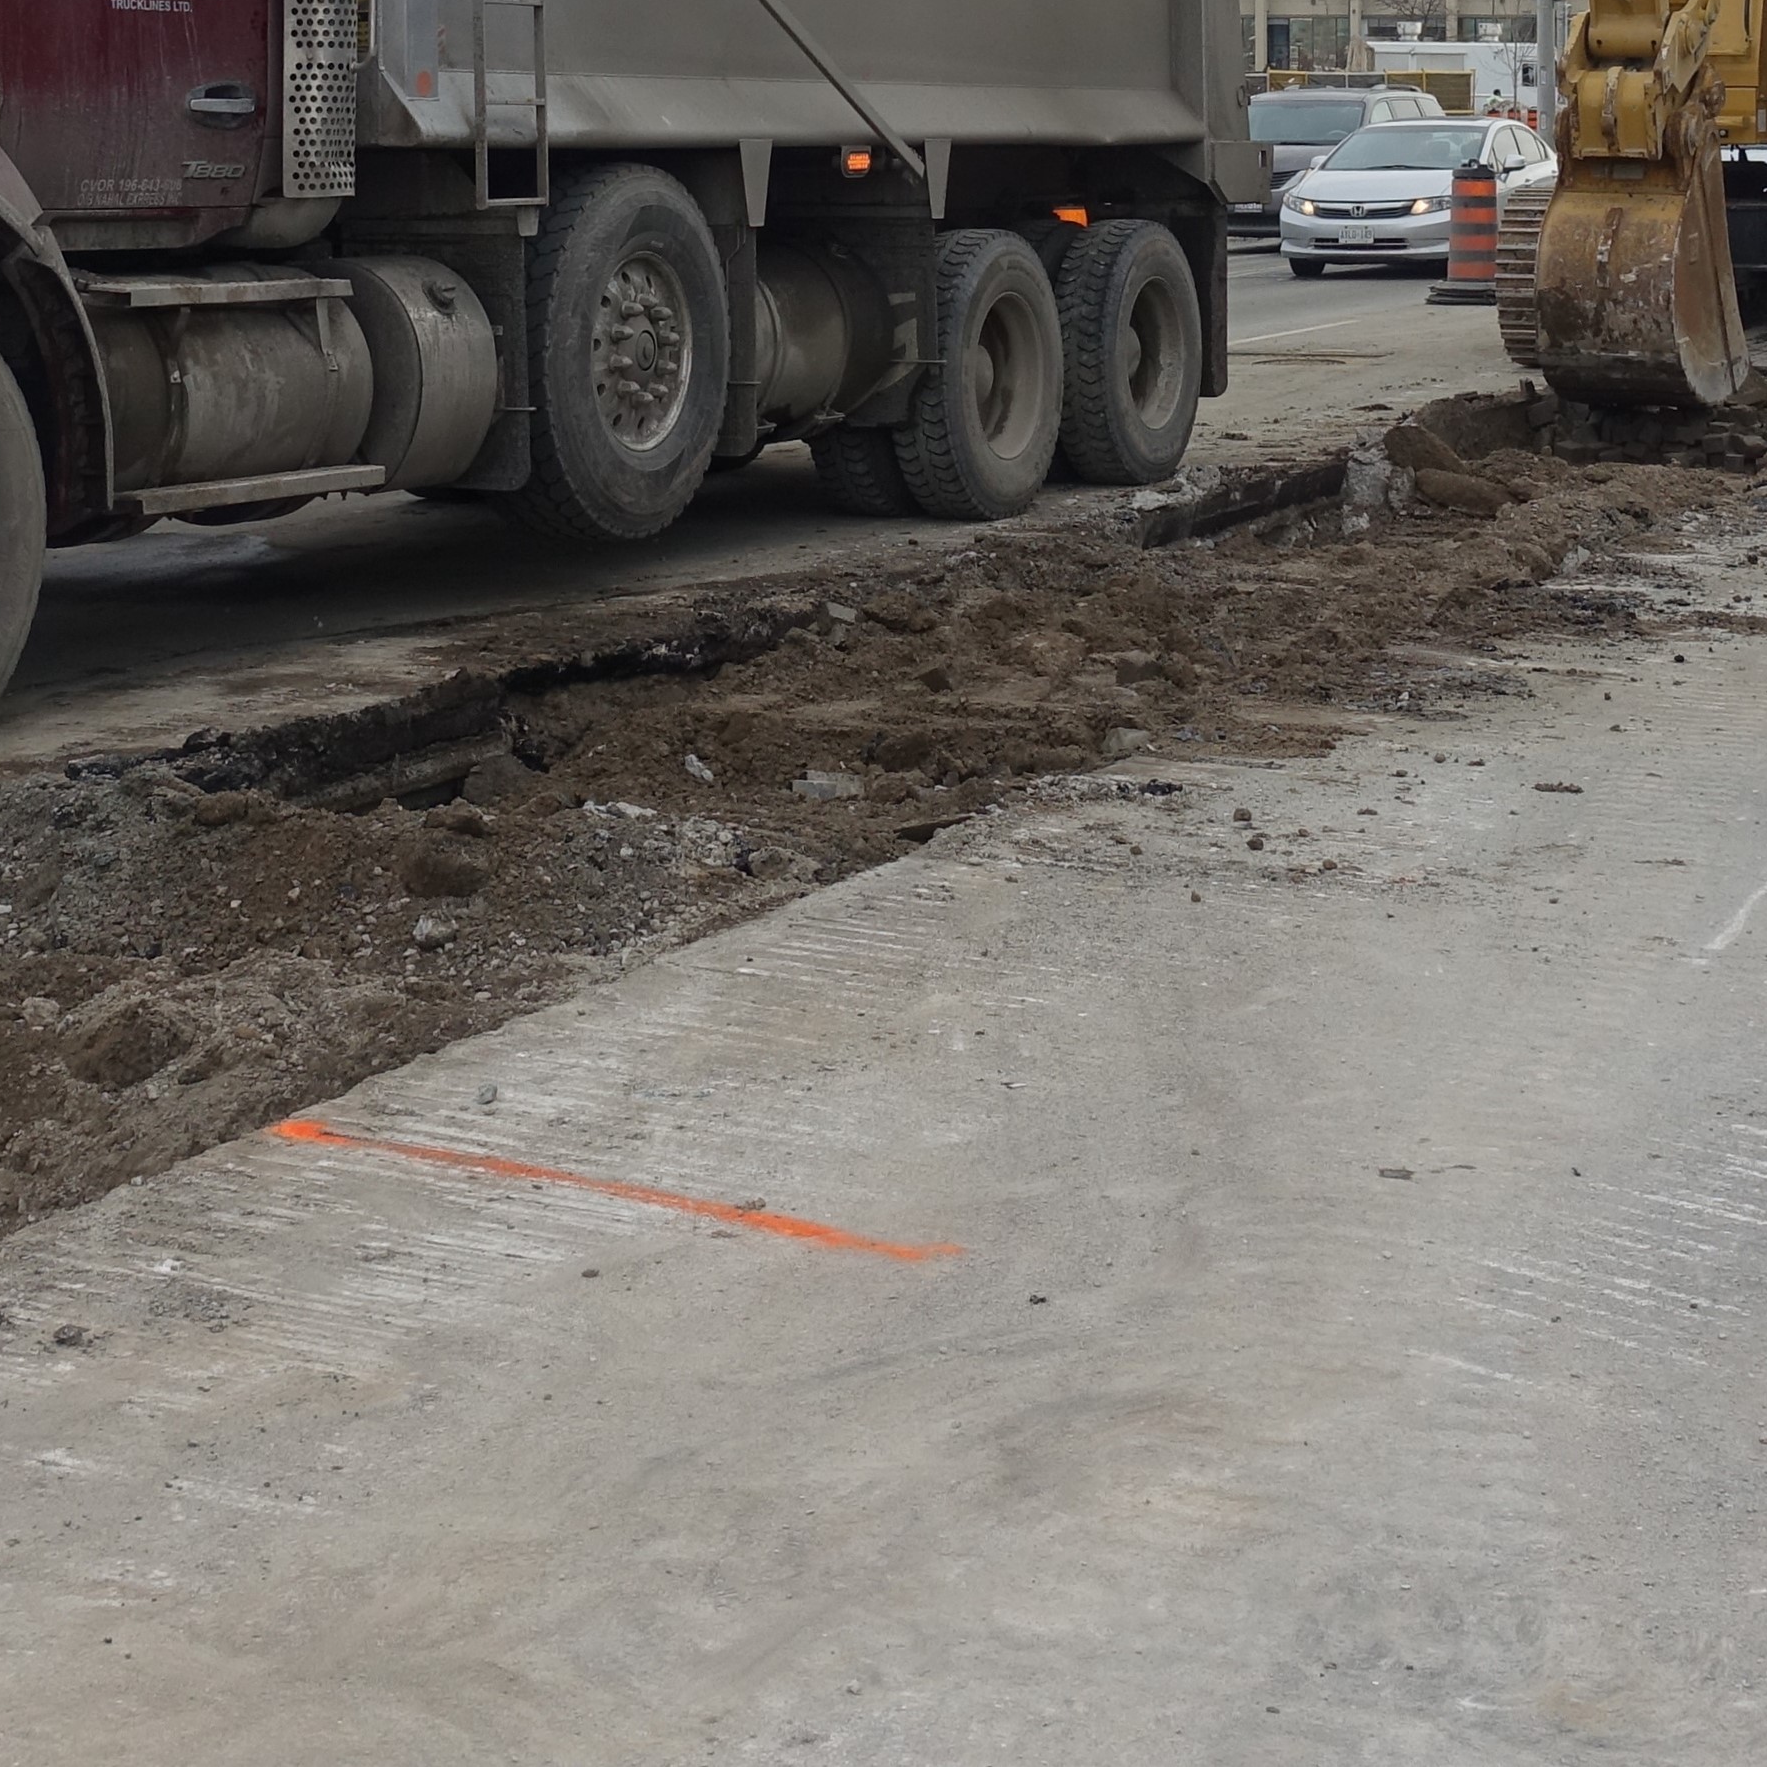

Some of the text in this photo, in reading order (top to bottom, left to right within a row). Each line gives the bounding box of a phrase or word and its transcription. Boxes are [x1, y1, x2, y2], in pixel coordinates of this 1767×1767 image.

[173, 1, 193, 13] LTD.
[182, 160, 245, 178] T880
[80, 178, 115, 192] CVOR
